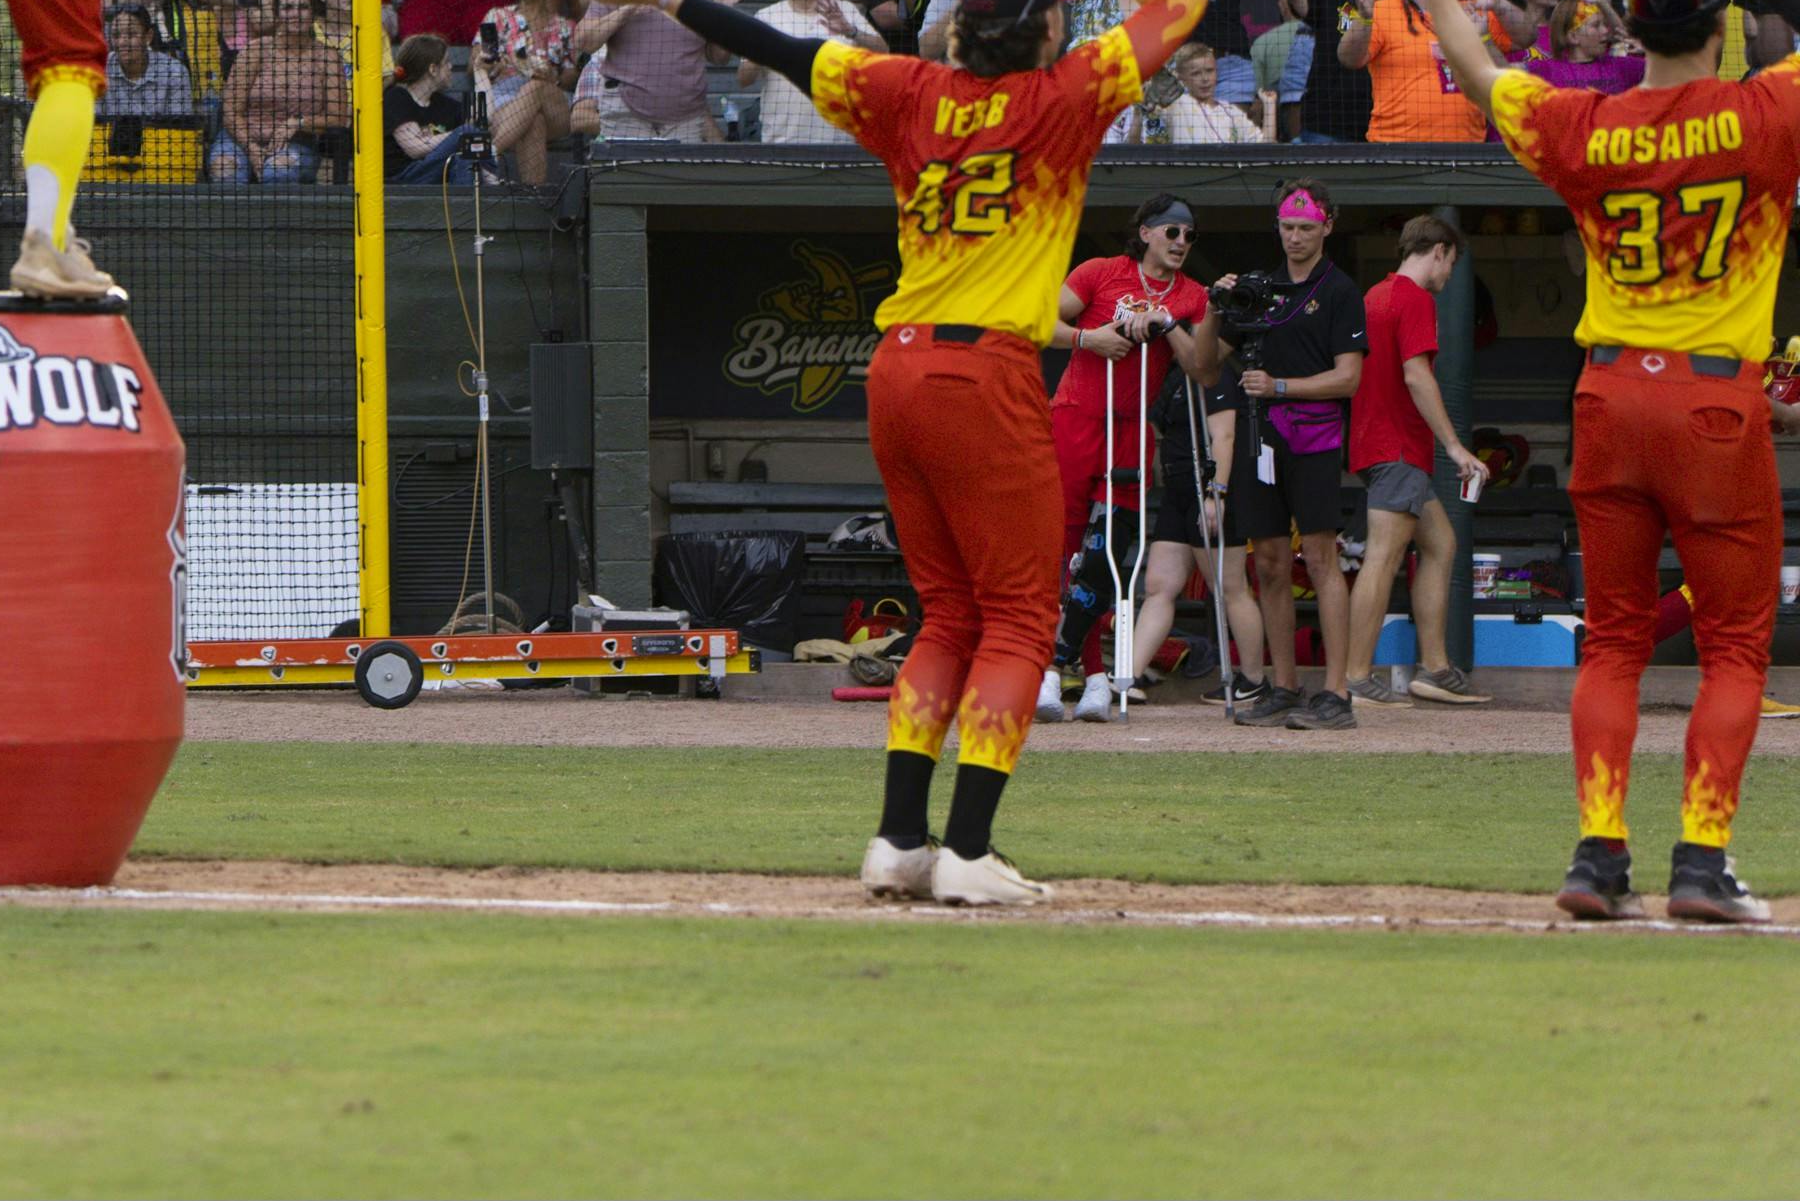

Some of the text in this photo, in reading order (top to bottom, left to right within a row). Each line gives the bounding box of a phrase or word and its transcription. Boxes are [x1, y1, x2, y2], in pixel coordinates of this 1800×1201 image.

[1586, 109, 1743, 166] ROSARIO
[1601, 175, 1747, 286] 37
[727, 318, 880, 379] Banana
